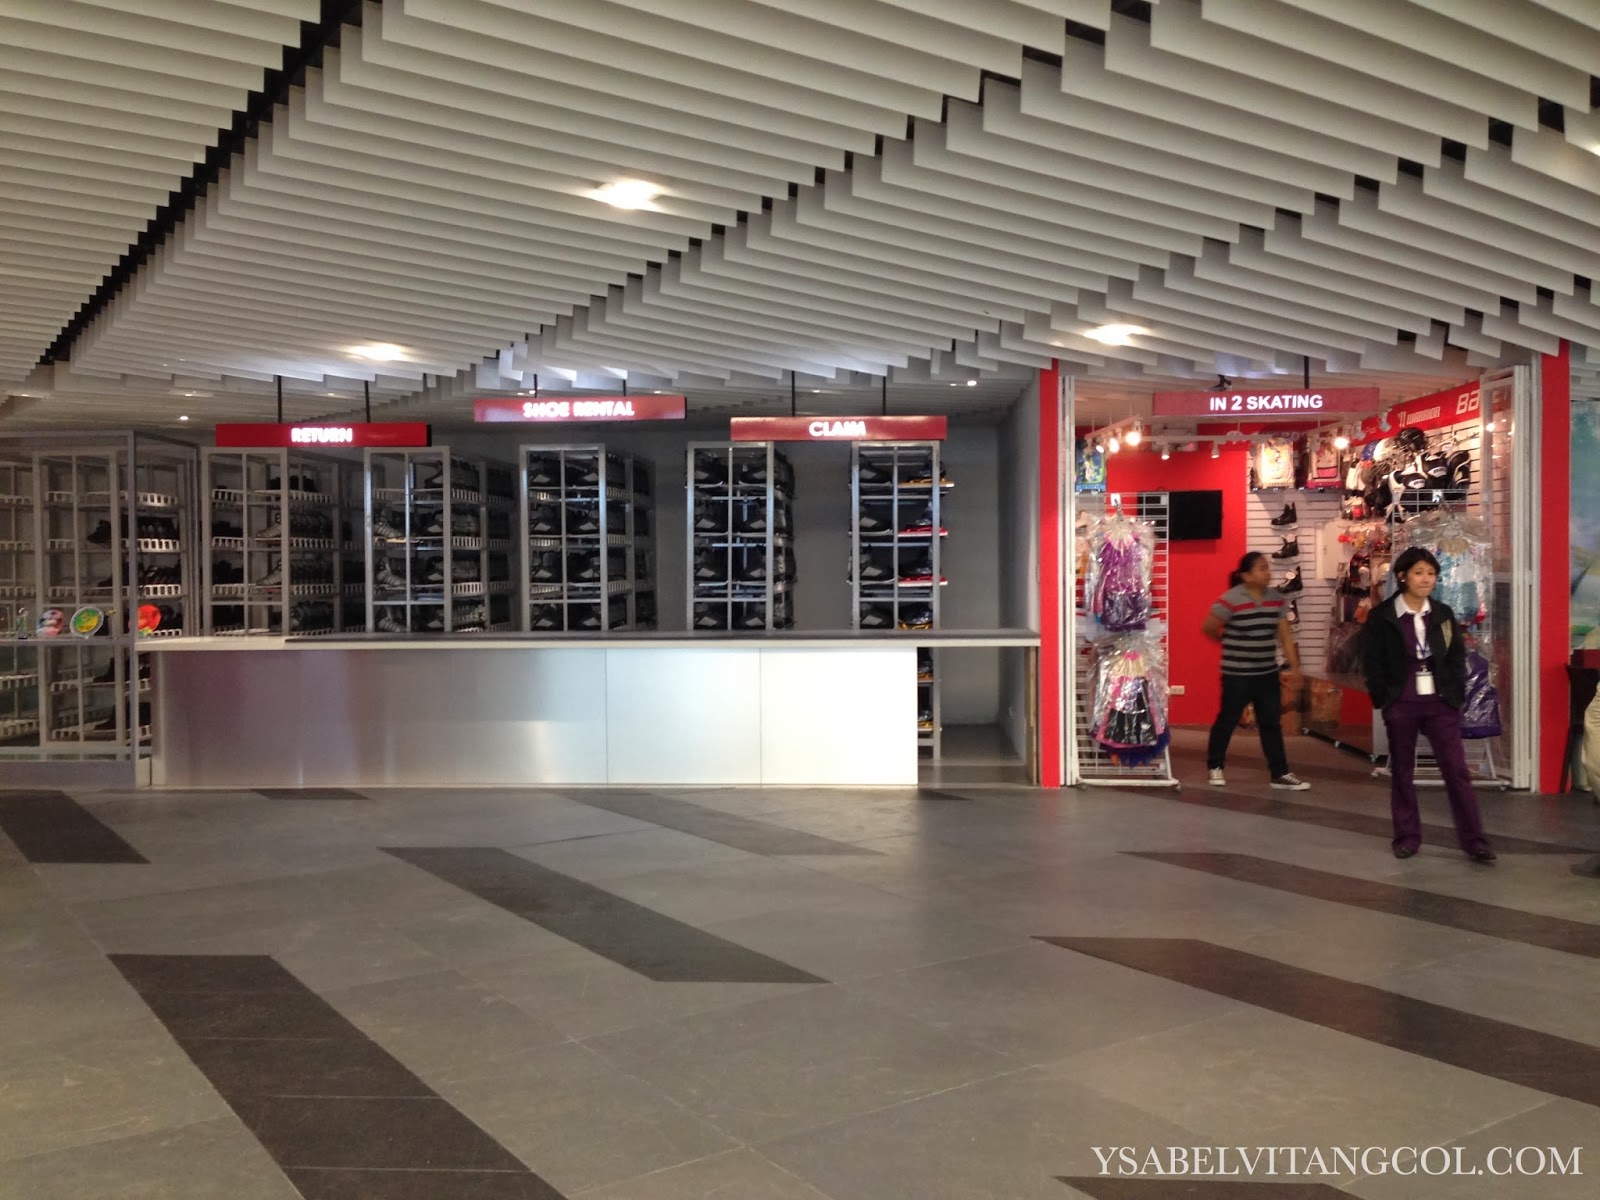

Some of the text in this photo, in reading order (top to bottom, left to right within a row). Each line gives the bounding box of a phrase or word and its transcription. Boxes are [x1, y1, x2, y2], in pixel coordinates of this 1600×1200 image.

[523, 401, 635, 418] SHOE RENTAL
[1209, 394, 1323, 411] IN 2 SKATING
[291, 427, 353, 443] RETURN
[809, 421, 867, 437] CLAIM
